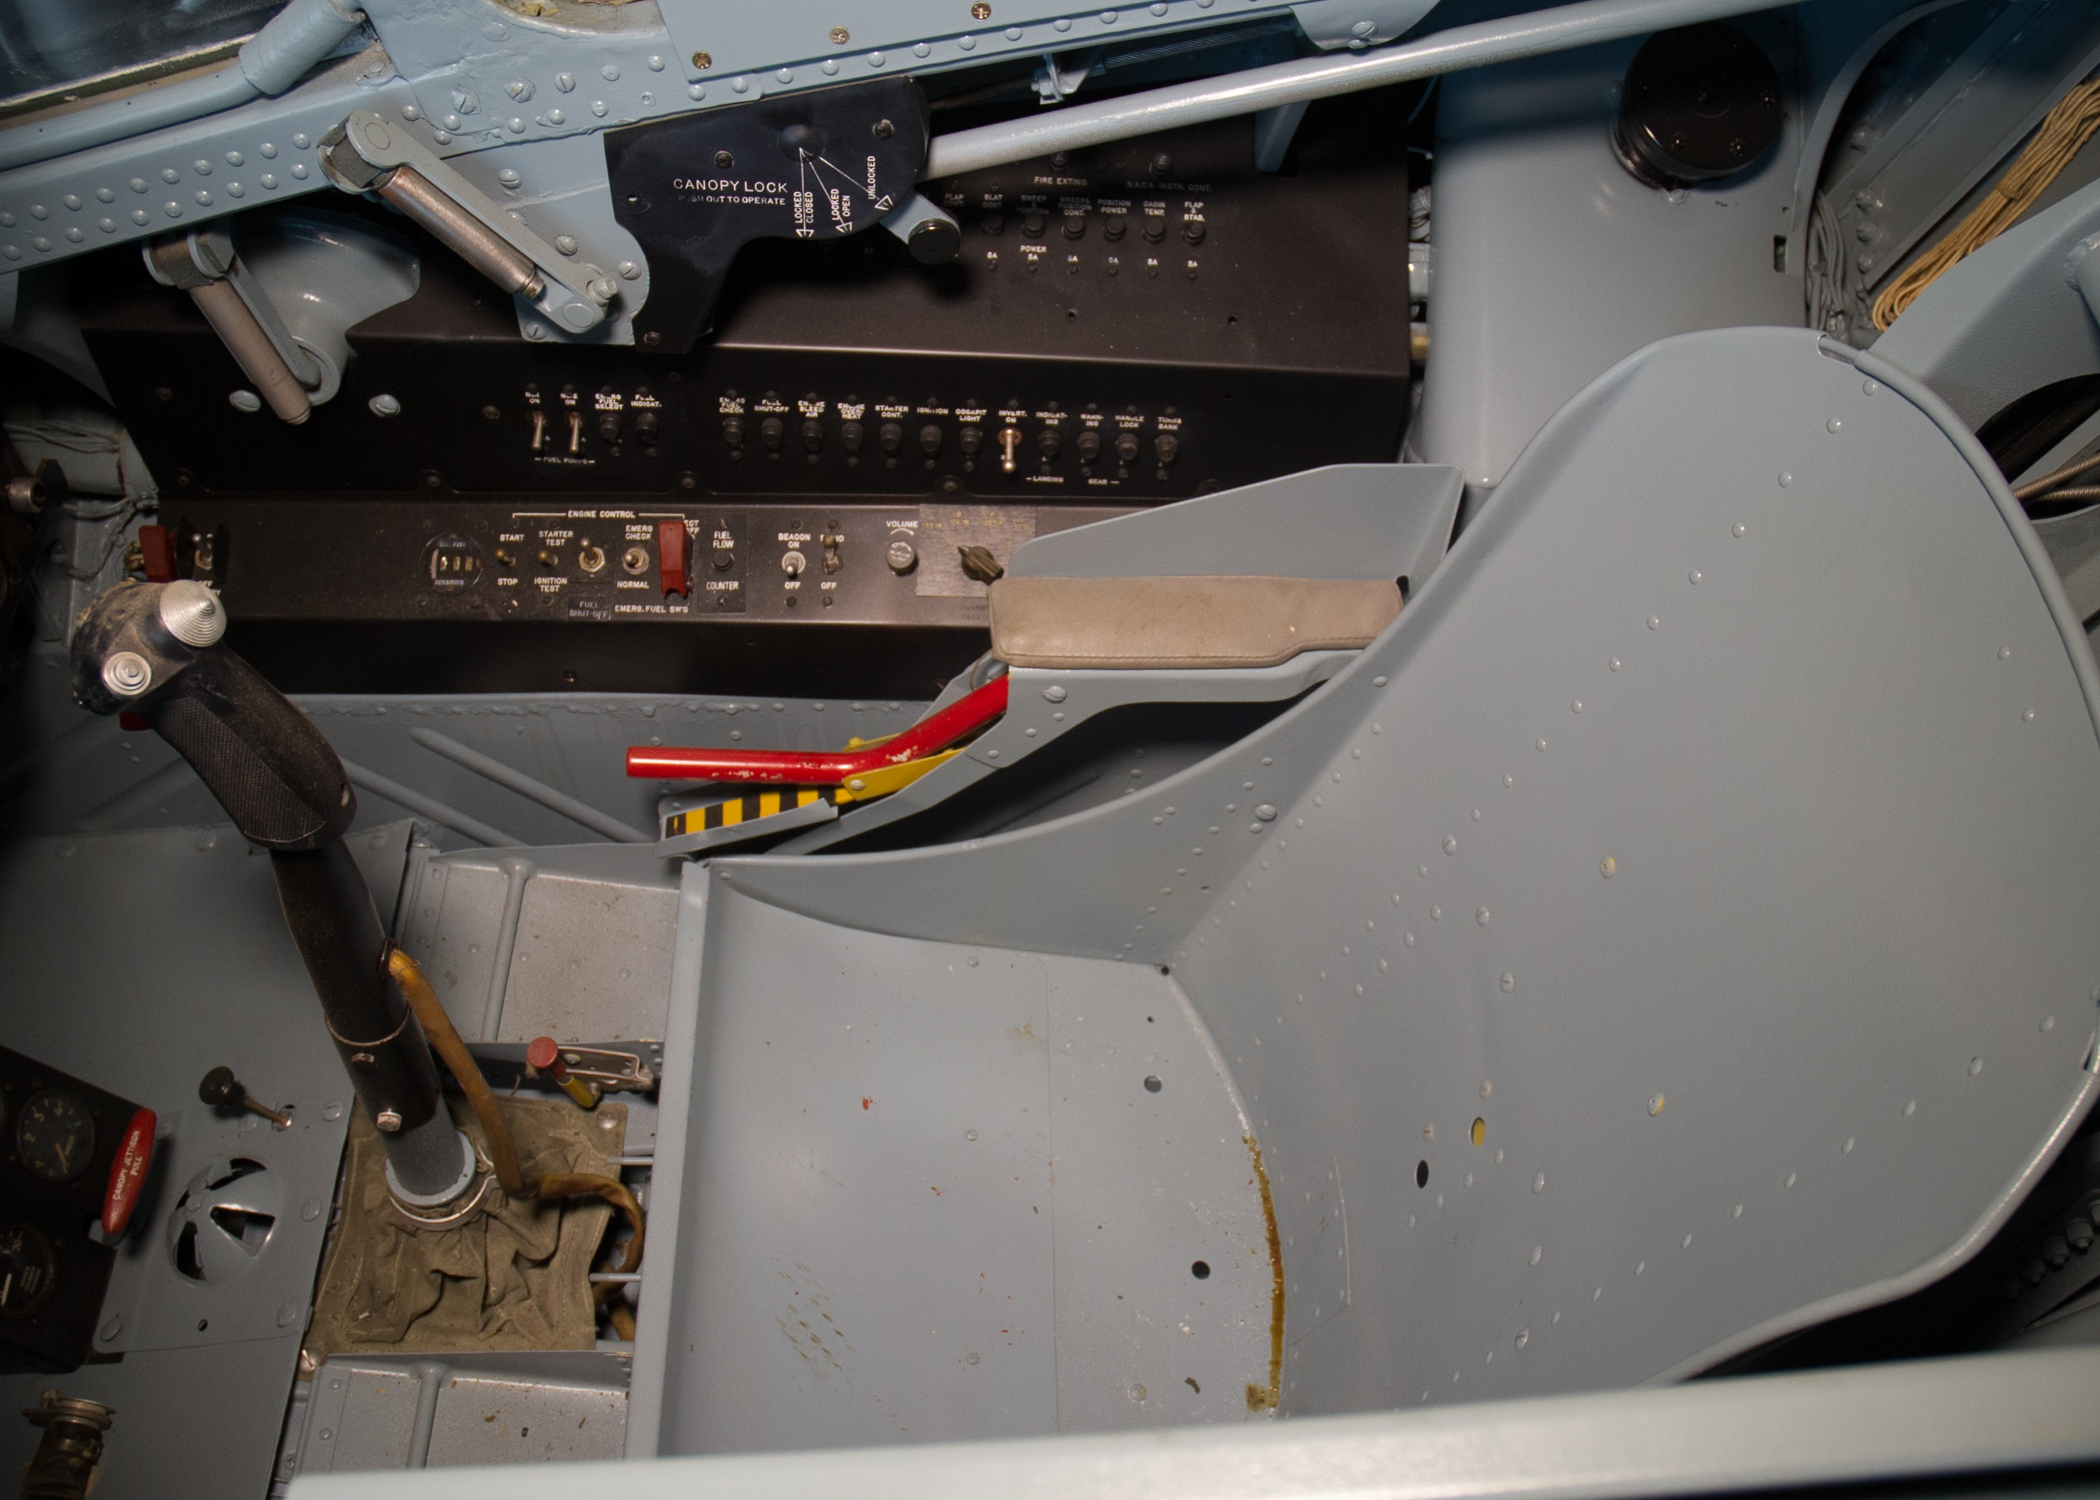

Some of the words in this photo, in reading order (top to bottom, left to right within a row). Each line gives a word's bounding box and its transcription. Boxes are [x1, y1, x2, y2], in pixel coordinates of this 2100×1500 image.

[867, 155, 876, 200] UNLOCKED
[1034, 176, 1053, 184] FIRE
[673, 178, 740, 191] CANOPY
[744, 181, 788, 193] LOCK
[1188, 184, 1212, 192] CONT.
[706, 196, 725, 204] OUT
[727, 196, 740, 204] TO
[742, 196, 786, 206] OPERATE
[830, 188, 840, 220] LOCKED
[1098, 198, 1132, 206] POSITION
[793, 191, 803, 224] LOCKED
[804, 191, 814, 224] CLOSED
[842, 195, 850, 217] OPEN
[1058, 202, 1092, 210] POSITION
[1100, 206, 1128, 214] POWER
[630, 400, 662, 408] INDICAT.
[1033, 476, 1064, 484] LANDING
[568, 510, 597, 518] ENGINE
[600, 510, 636, 518] CONTROL
[886, 520, 918, 528] VOLUME
[499, 534, 525, 542] START
[538, 530, 574, 538] STARTER
[625, 532, 652, 540] CHECK
[714, 531, 732, 540] FUEL
[778, 533, 811, 541] BEACON
[546, 538, 566, 546] TEST
[712, 540, 734, 548] FLOW
[497, 578, 518, 586] STOP
[706, 582, 739, 590] COUNTER
[784, 582, 801, 590] OFF
[820, 582, 837, 590] OFF
[540, 584, 560, 592] TEST
[579, 600, 598, 608] FUEL
[569, 610, 609, 618] SHUT-OFF
[34, 1112, 44, 1122] 3
[23, 1132, 36, 1143] 2
[112, 1168, 128, 1200] CANOPY
[124, 1130, 140, 1166] JETTISON
[130, 1156, 143, 1176] PULL
